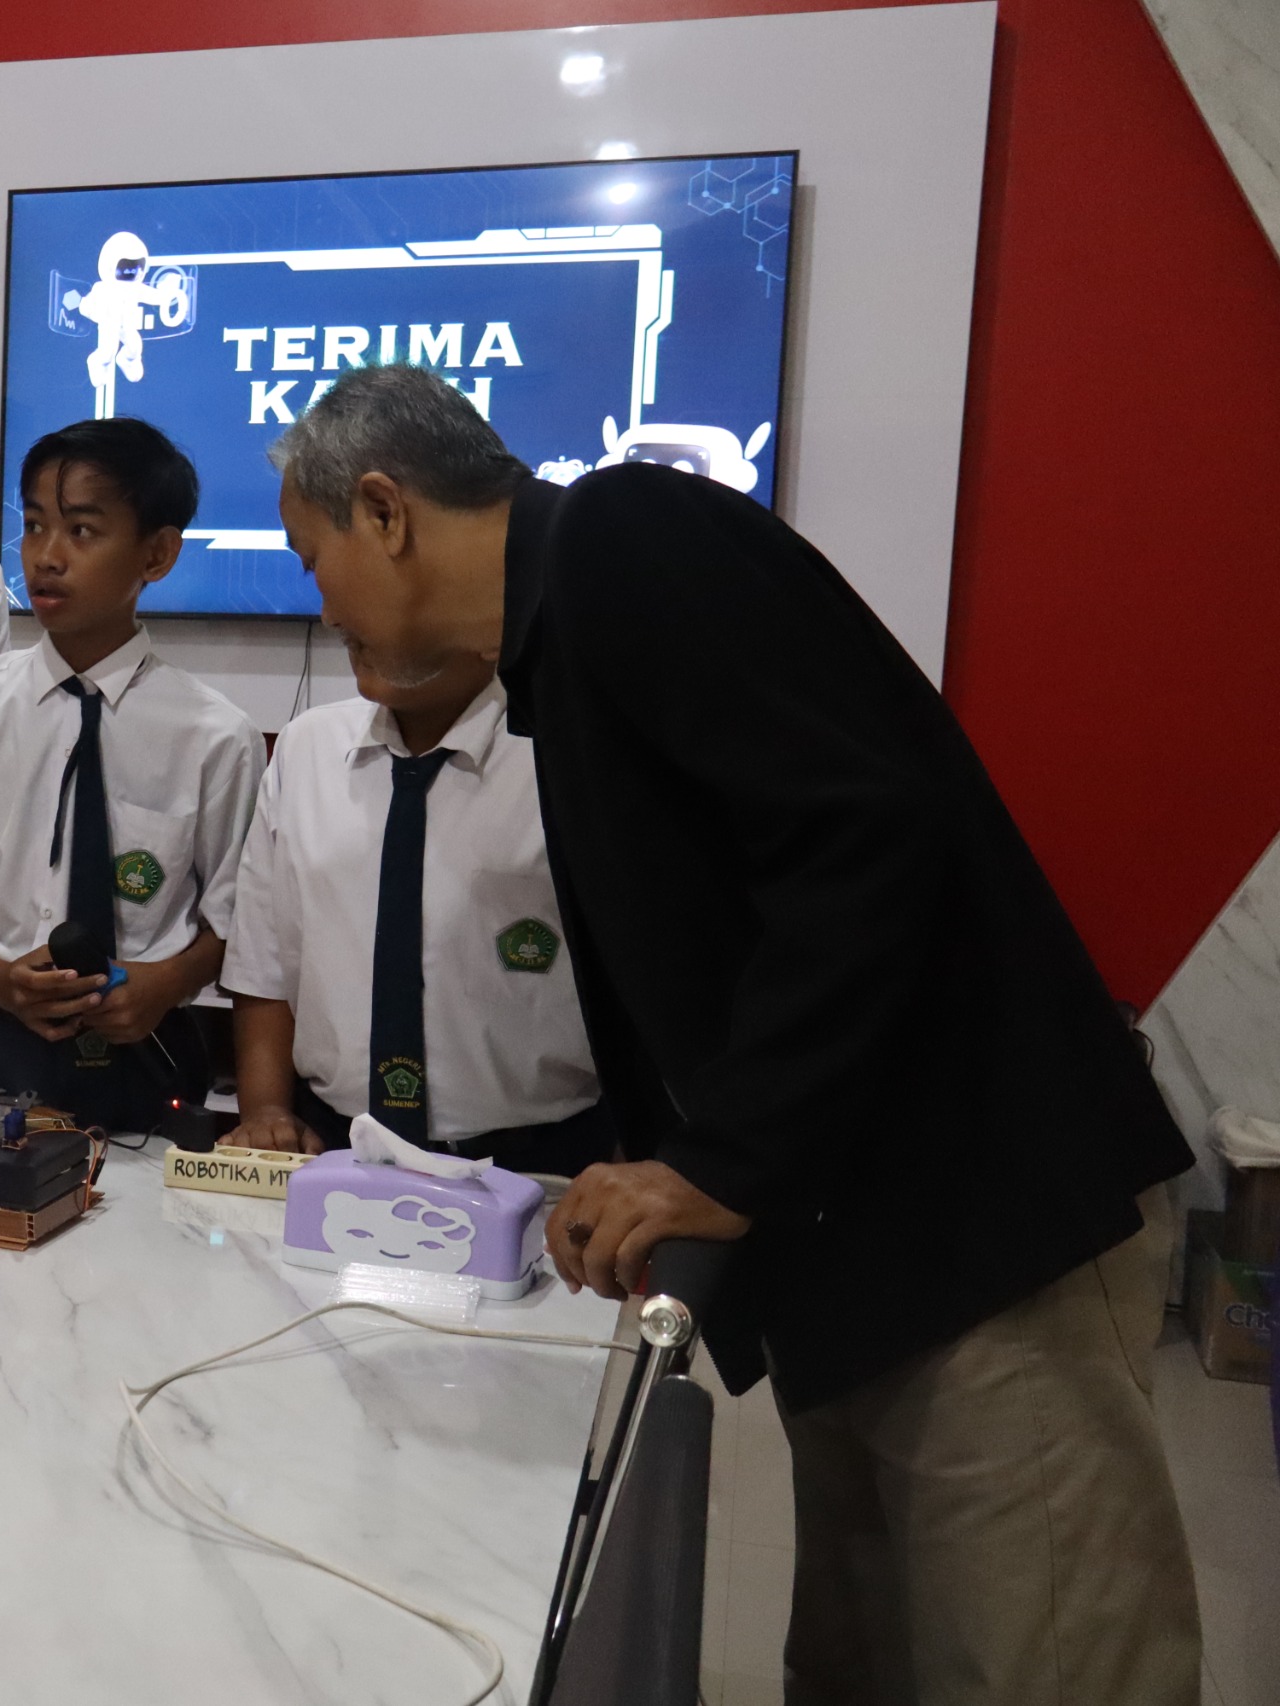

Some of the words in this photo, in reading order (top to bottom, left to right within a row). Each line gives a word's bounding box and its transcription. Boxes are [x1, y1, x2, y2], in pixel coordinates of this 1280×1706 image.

[223, 322, 523, 372] TERIMA
[392, 1057, 421, 1071] NEGERI
[383, 1099, 421, 1109] SUMENEP
[174, 1159, 260, 1184] ROBOTIKA
